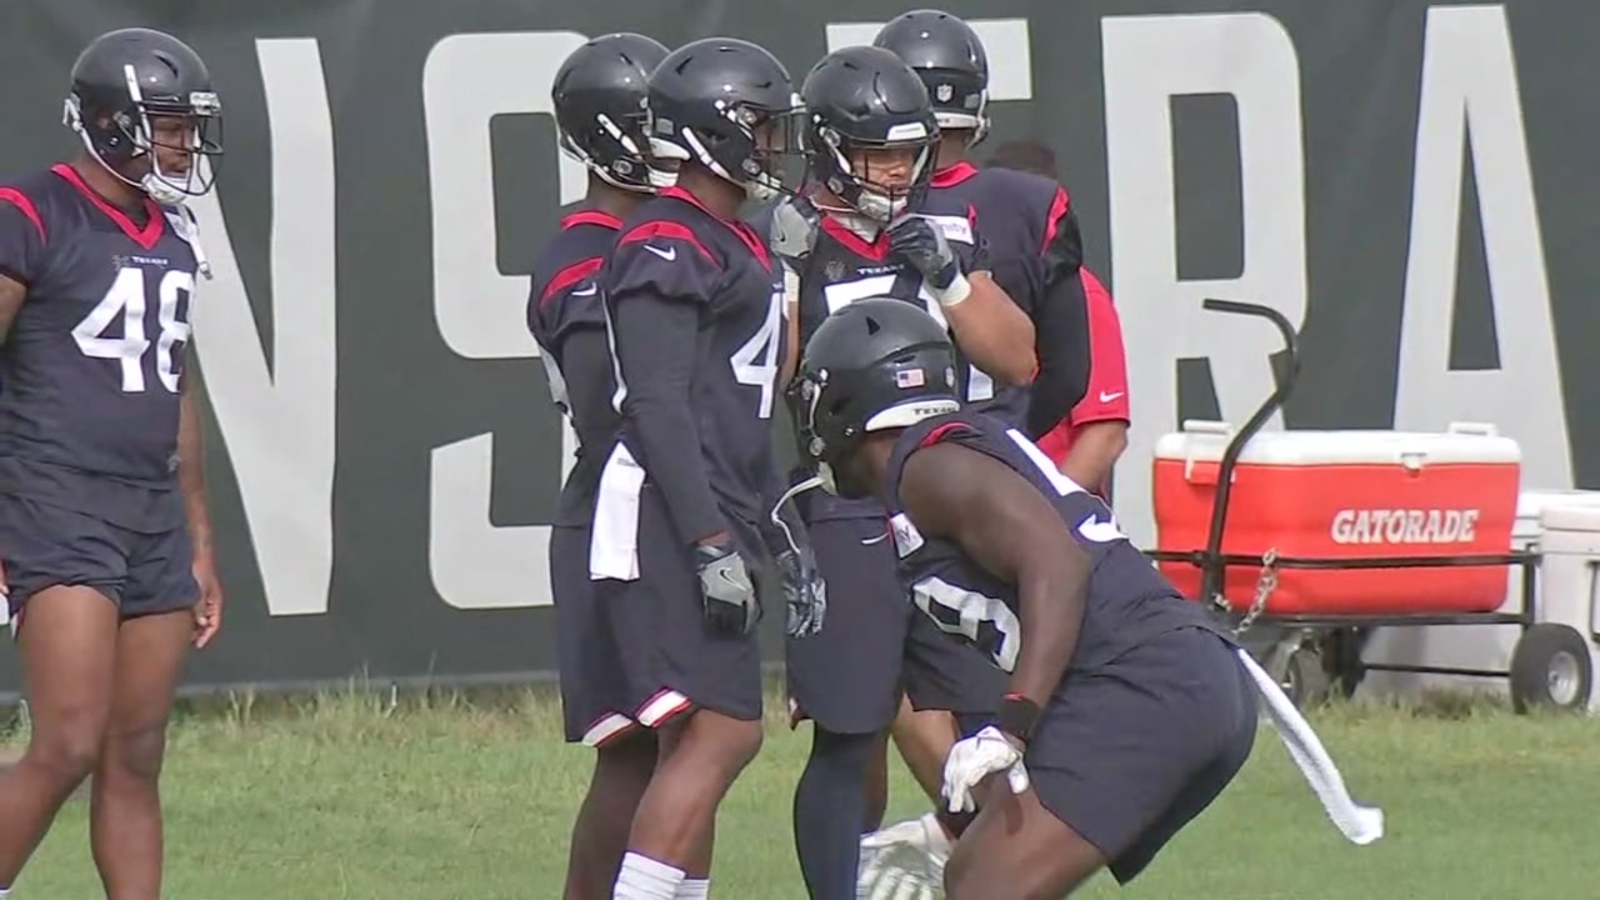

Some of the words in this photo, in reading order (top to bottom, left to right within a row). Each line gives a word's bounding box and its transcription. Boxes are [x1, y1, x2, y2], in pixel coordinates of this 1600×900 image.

[71, 266, 193, 393] 48
[730, 291, 781, 419] 4
[1331, 509, 1480, 544] GATORADE
